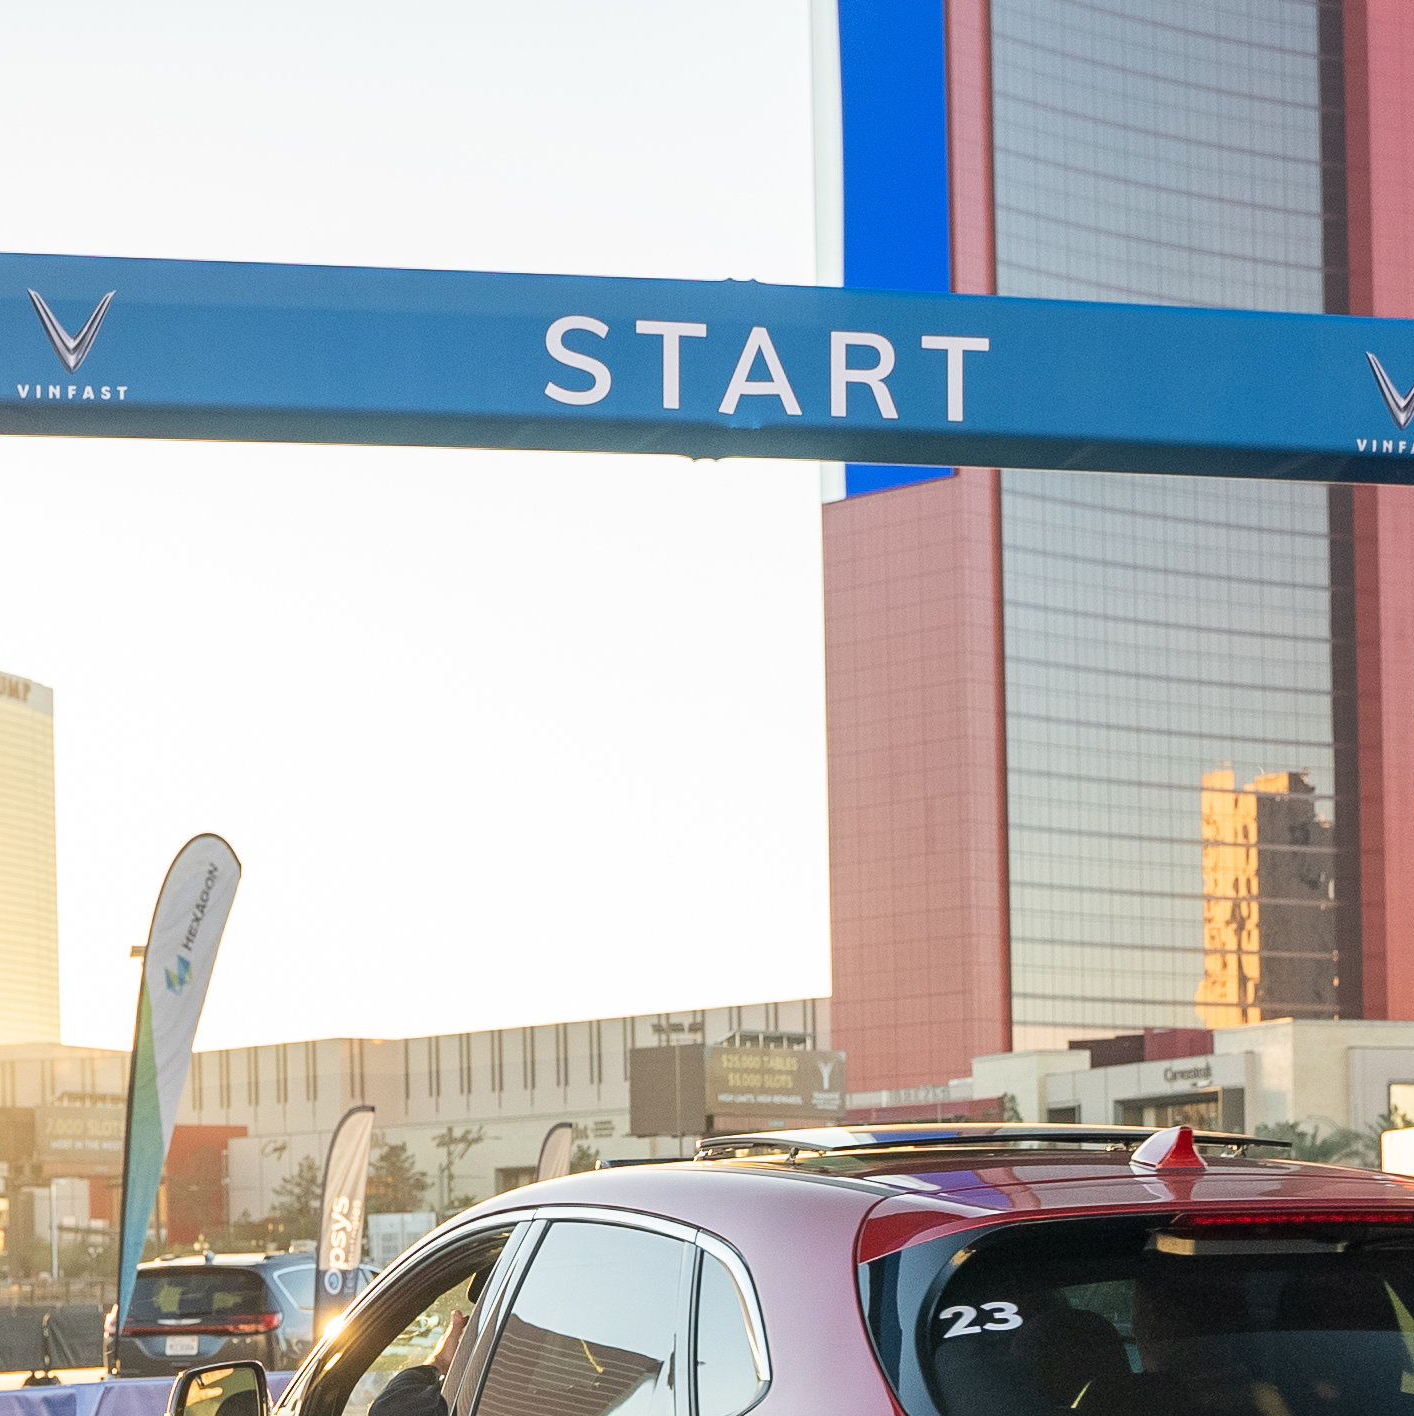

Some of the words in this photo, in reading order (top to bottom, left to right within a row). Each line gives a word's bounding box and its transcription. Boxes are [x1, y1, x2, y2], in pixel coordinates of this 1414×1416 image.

[16, 383, 130, 400] VINFAST
[543, 315, 990, 423] START
[181, 862, 219, 951] HEXAGON
[938, 1300, 1024, 1339] 23
